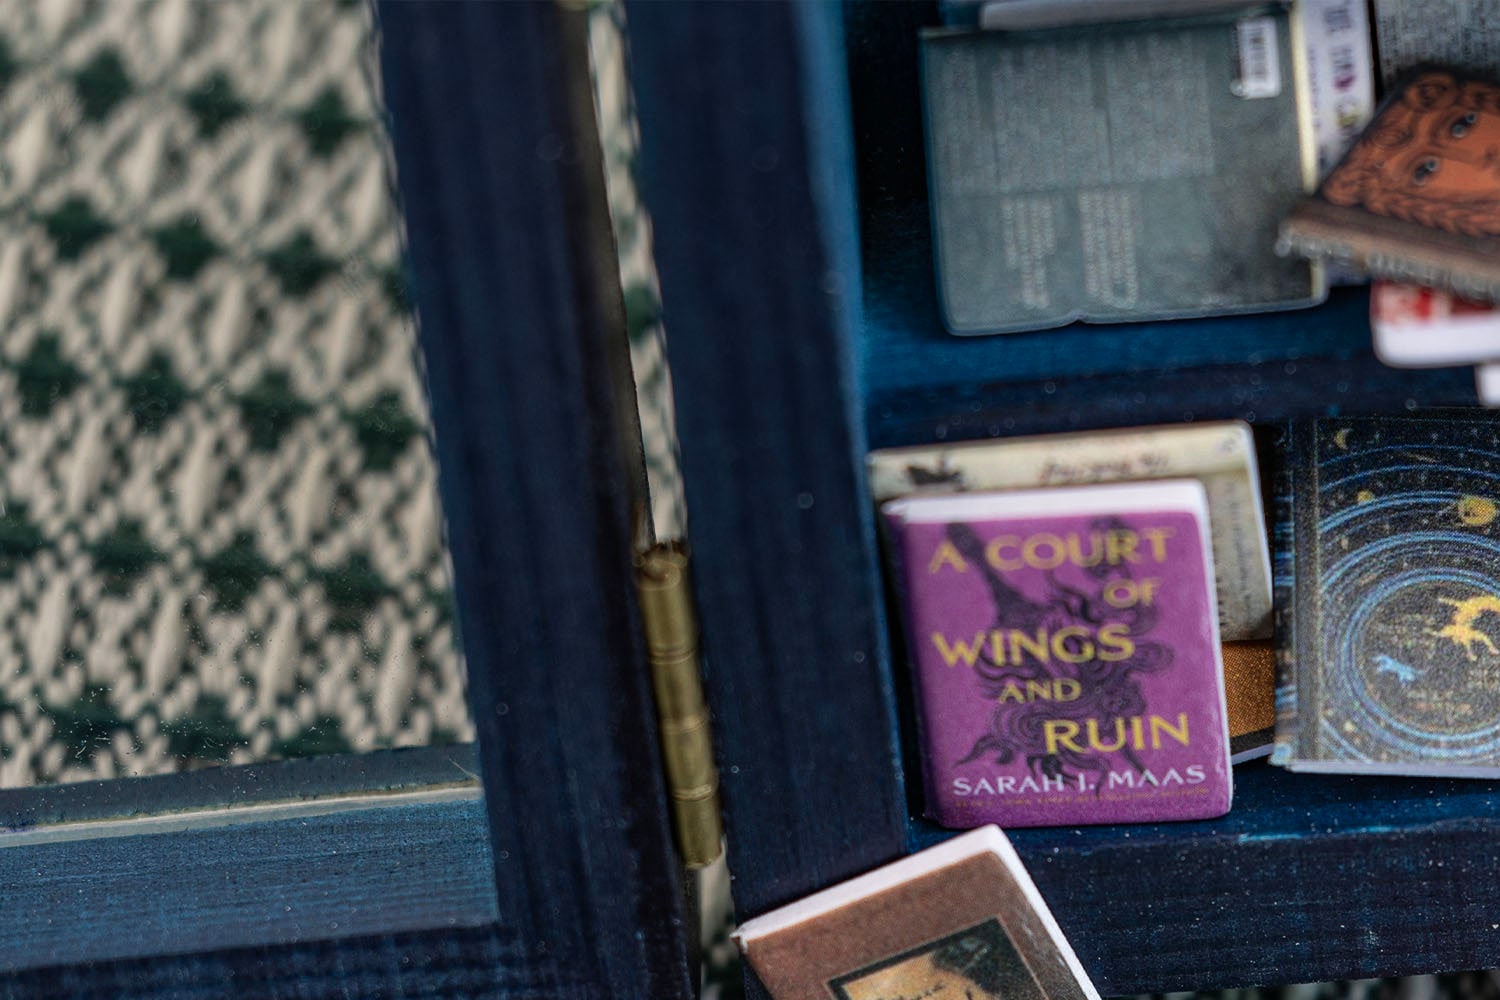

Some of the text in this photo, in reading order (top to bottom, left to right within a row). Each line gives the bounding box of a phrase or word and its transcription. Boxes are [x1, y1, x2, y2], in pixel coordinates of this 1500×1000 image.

[928, 526, 1177, 574] A COURT
[1102, 578, 1163, 608] OF
[931, 624, 1135, 669] WINGS
[998, 678, 1082, 704] AND
[1043, 712, 1191, 754] RUIN
[952, 773, 1065, 796] SARAH
[1108, 764, 1207, 789] MAAS
